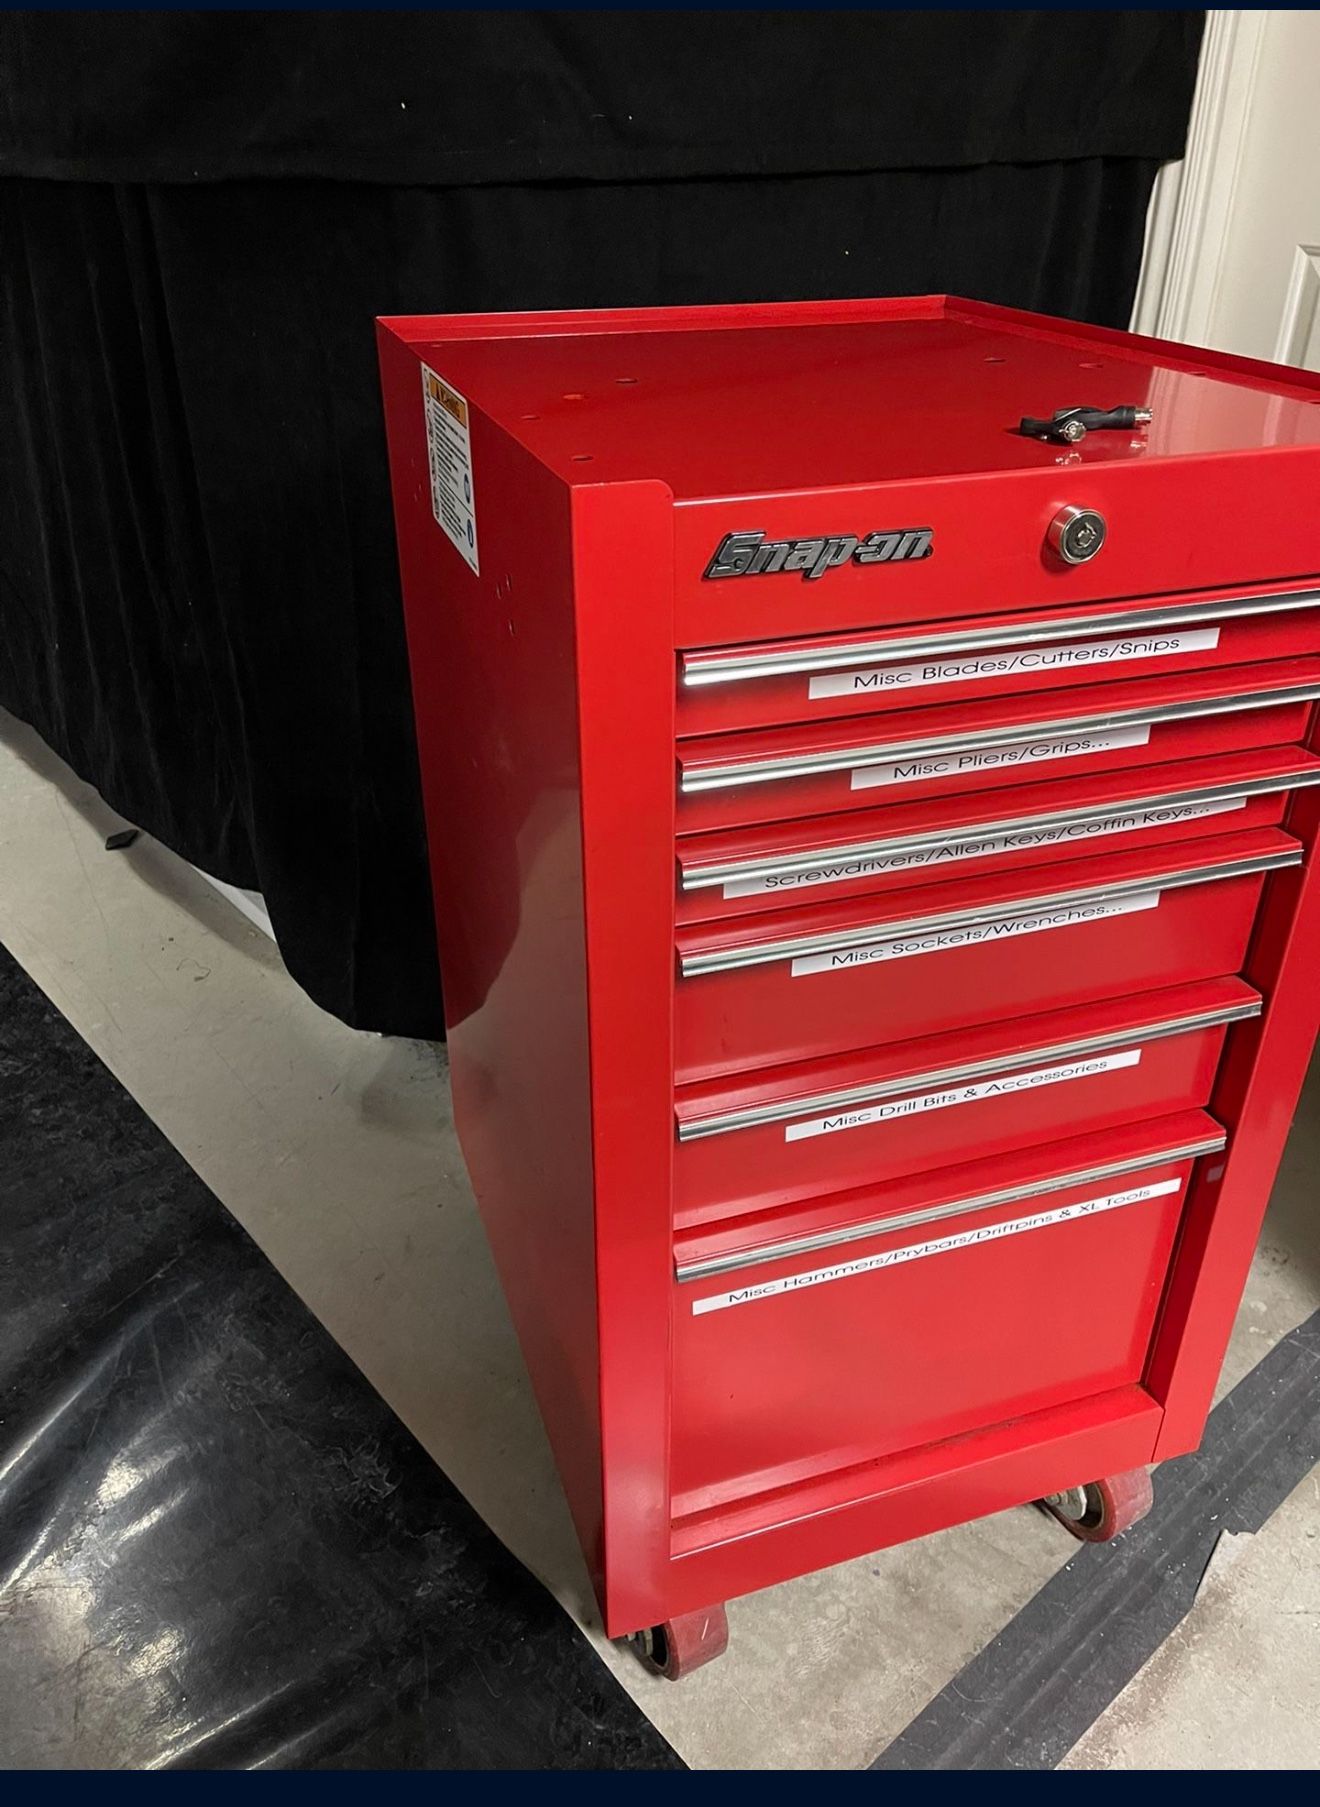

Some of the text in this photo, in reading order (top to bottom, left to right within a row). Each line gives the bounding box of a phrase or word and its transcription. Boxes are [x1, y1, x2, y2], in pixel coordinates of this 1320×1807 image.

[704, 527, 933, 580] Snap-on
[854, 638, 1180, 688] Misc Blades/Cutters/Snips
[894, 738, 1110, 778] Misc Pliers/Grips...
[765, 806, 1209, 888] Screwdrivers/Allen Keys/Coffin Keys...
[832, 906, 1122, 965] Misc Sockets/Wrenches...
[823, 1059, 1108, 1130] Misc Drill Bits & Accessories
[729, 1188, 1150, 1303] Misc Hammers/Prybars/Driftpins & XL Tools
